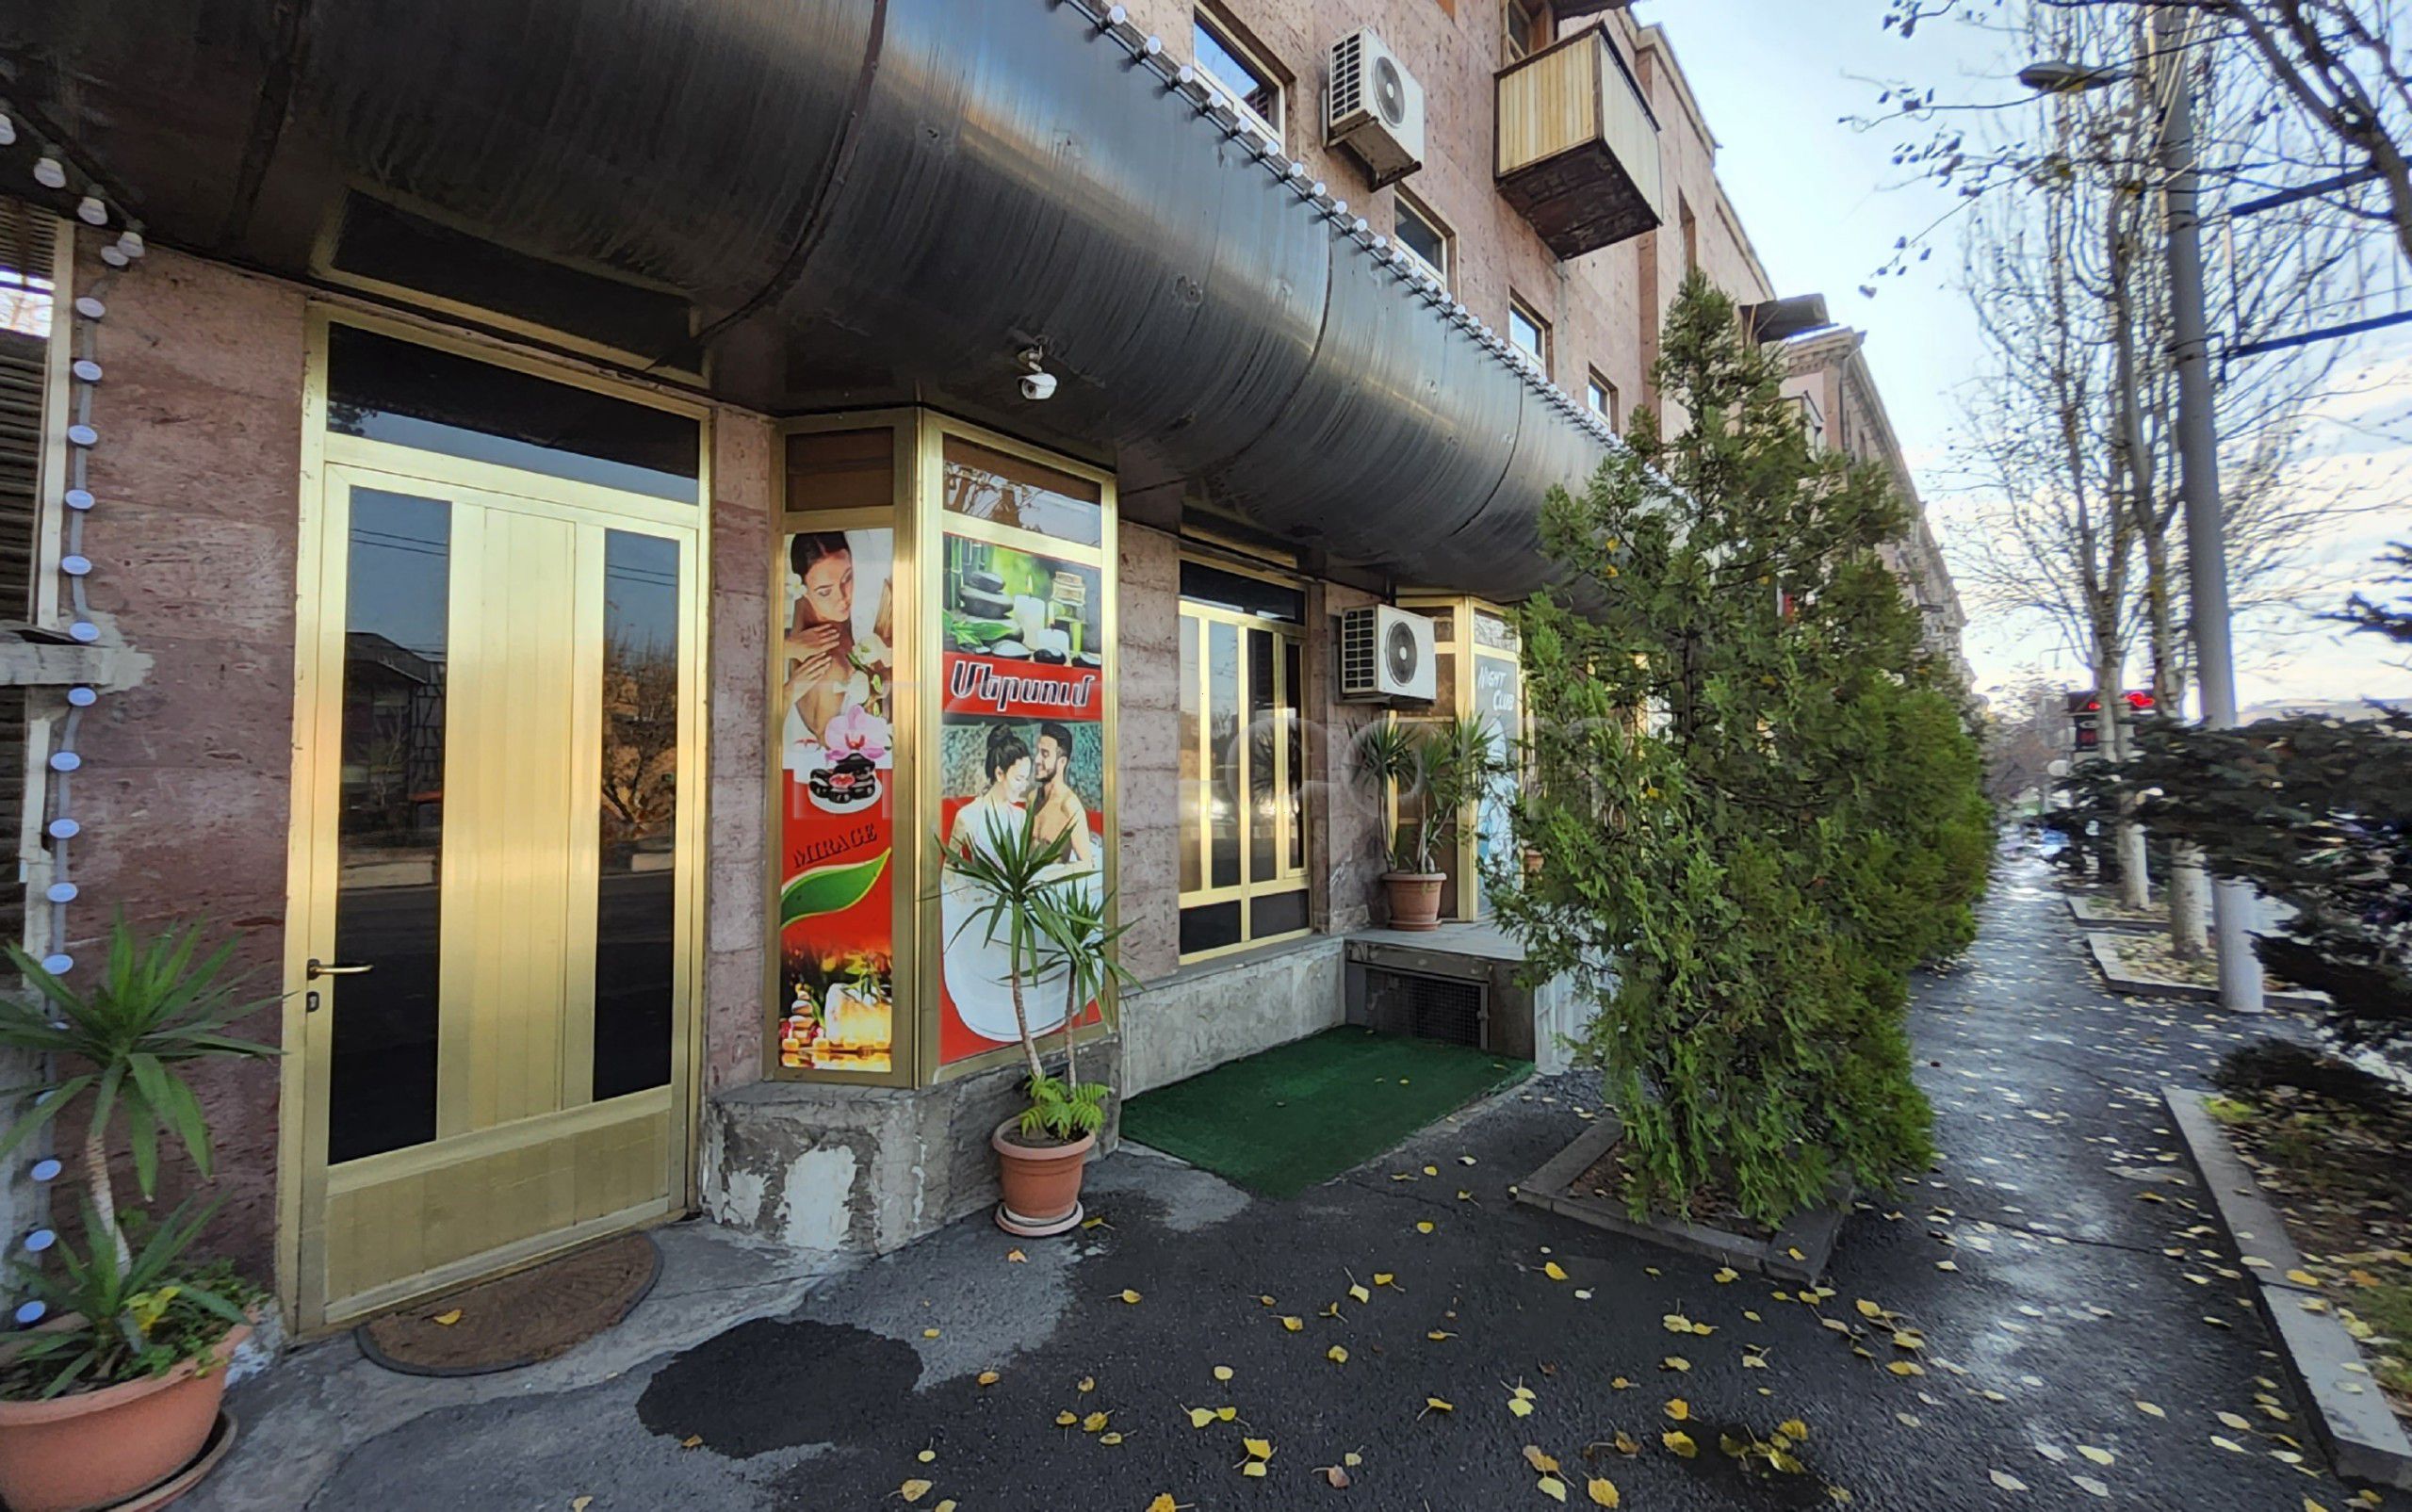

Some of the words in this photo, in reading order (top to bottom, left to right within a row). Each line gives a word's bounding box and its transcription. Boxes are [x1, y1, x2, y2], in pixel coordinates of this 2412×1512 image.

[951, 660, 1095, 711] Մերսում
[1478, 665, 1507, 690] NIGHT
[1492, 689, 1515, 711] CLUB
[793, 822, 878, 868] MIRAGE
